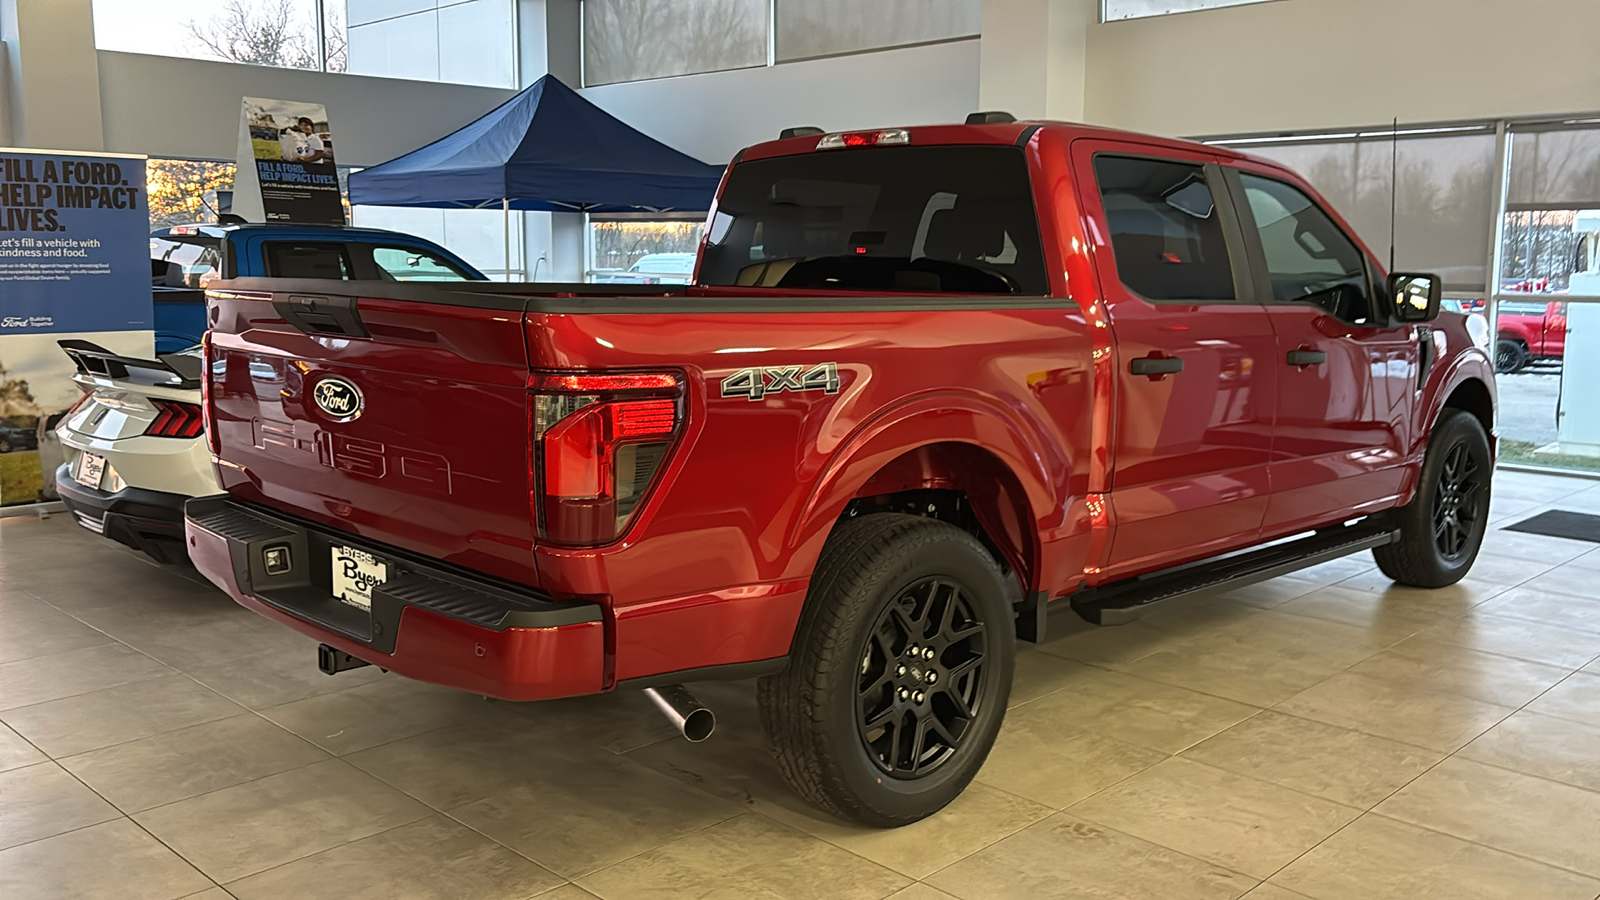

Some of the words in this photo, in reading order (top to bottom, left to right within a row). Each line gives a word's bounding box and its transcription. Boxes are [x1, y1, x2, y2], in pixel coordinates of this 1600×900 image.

[43, 160, 58, 183] A
[62, 161, 128, 186] FORD.
[257, 162, 275, 172] FILL
[276, 163, 282, 172] A
[283, 163, 307, 174] FORD.
[260, 171, 280, 181] HELP
[282, 172, 311, 183] IMPACT
[312, 174, 337, 184] LIVES.
[56, 185, 138, 209] IMPACT
[21, 238, 34, 248] fill
[36, 240, 43, 248] a
[44, 239, 78, 248] vehicle
[80, 239, 100, 248] with
[43, 249, 61, 257] and
[63, 248, 88, 257] food.
[1, 317, 28, 328] Ford
[320, 382, 351, 412] Ford
[342, 546, 373, 564] BYERS
